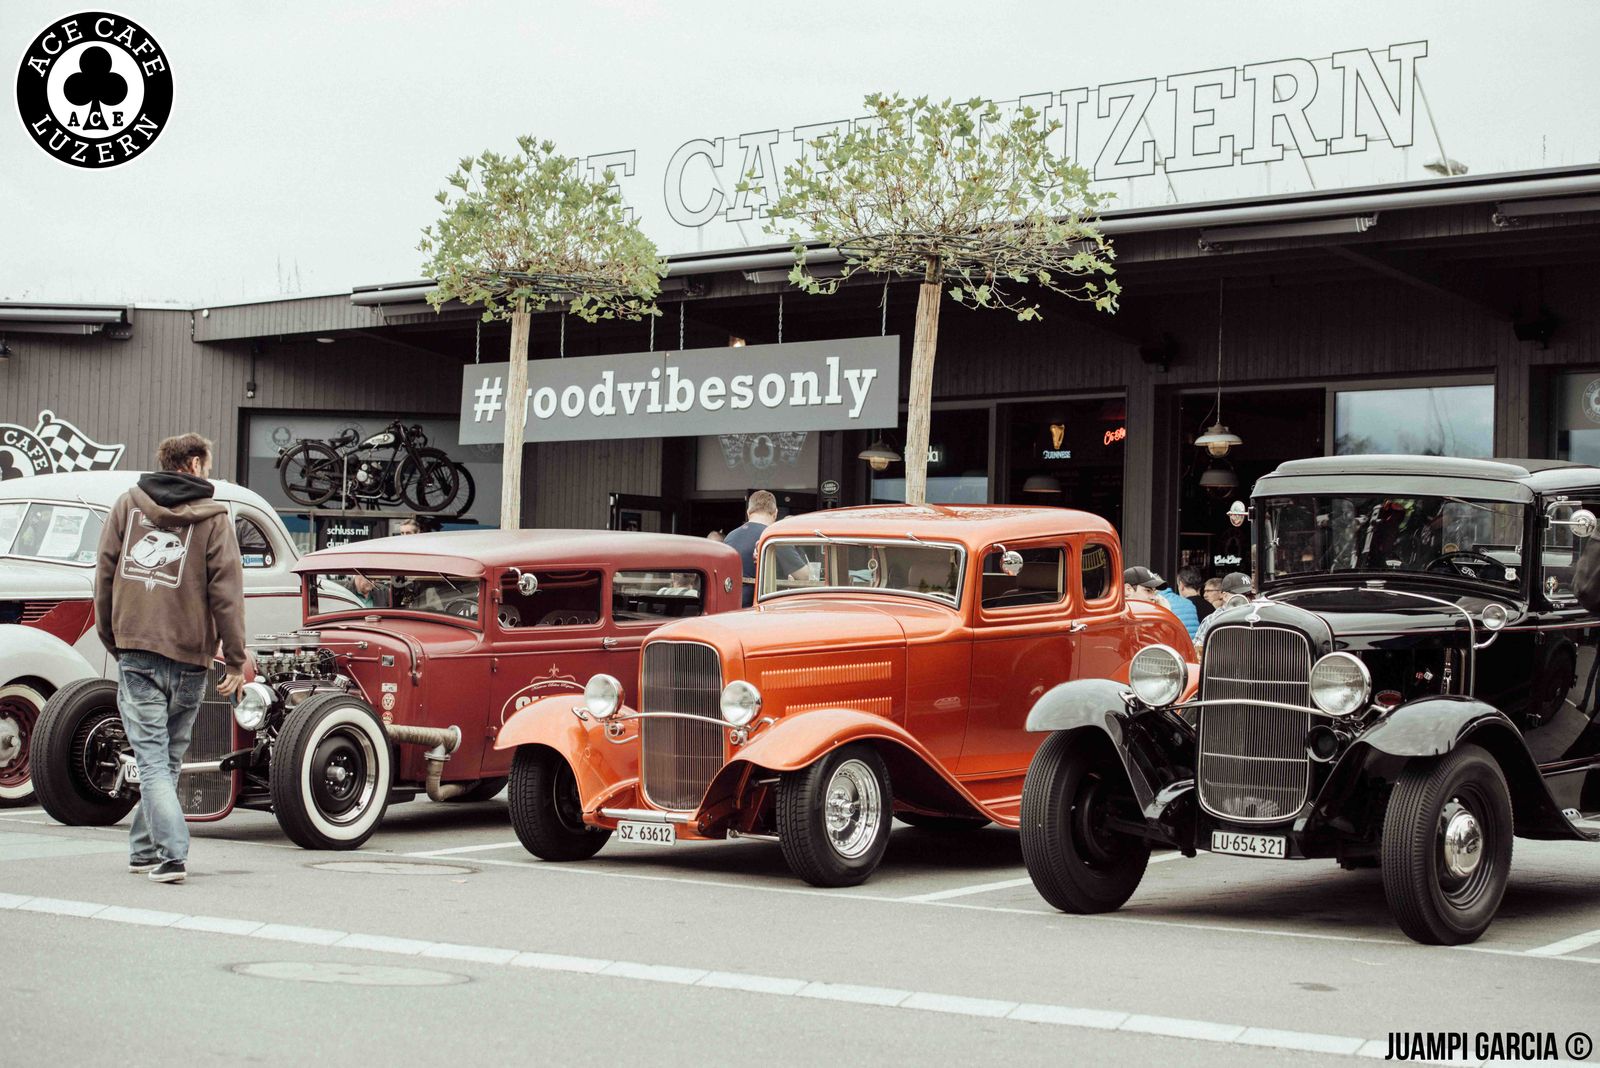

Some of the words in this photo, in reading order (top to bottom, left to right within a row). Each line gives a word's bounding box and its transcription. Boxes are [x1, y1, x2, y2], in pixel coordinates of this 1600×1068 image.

[473, 356, 878, 429] #oodvibesonly
[4, 430, 49, 471] CAFE
[326, 524, 355, 535] schluss
[355, 525, 369, 535] mit
